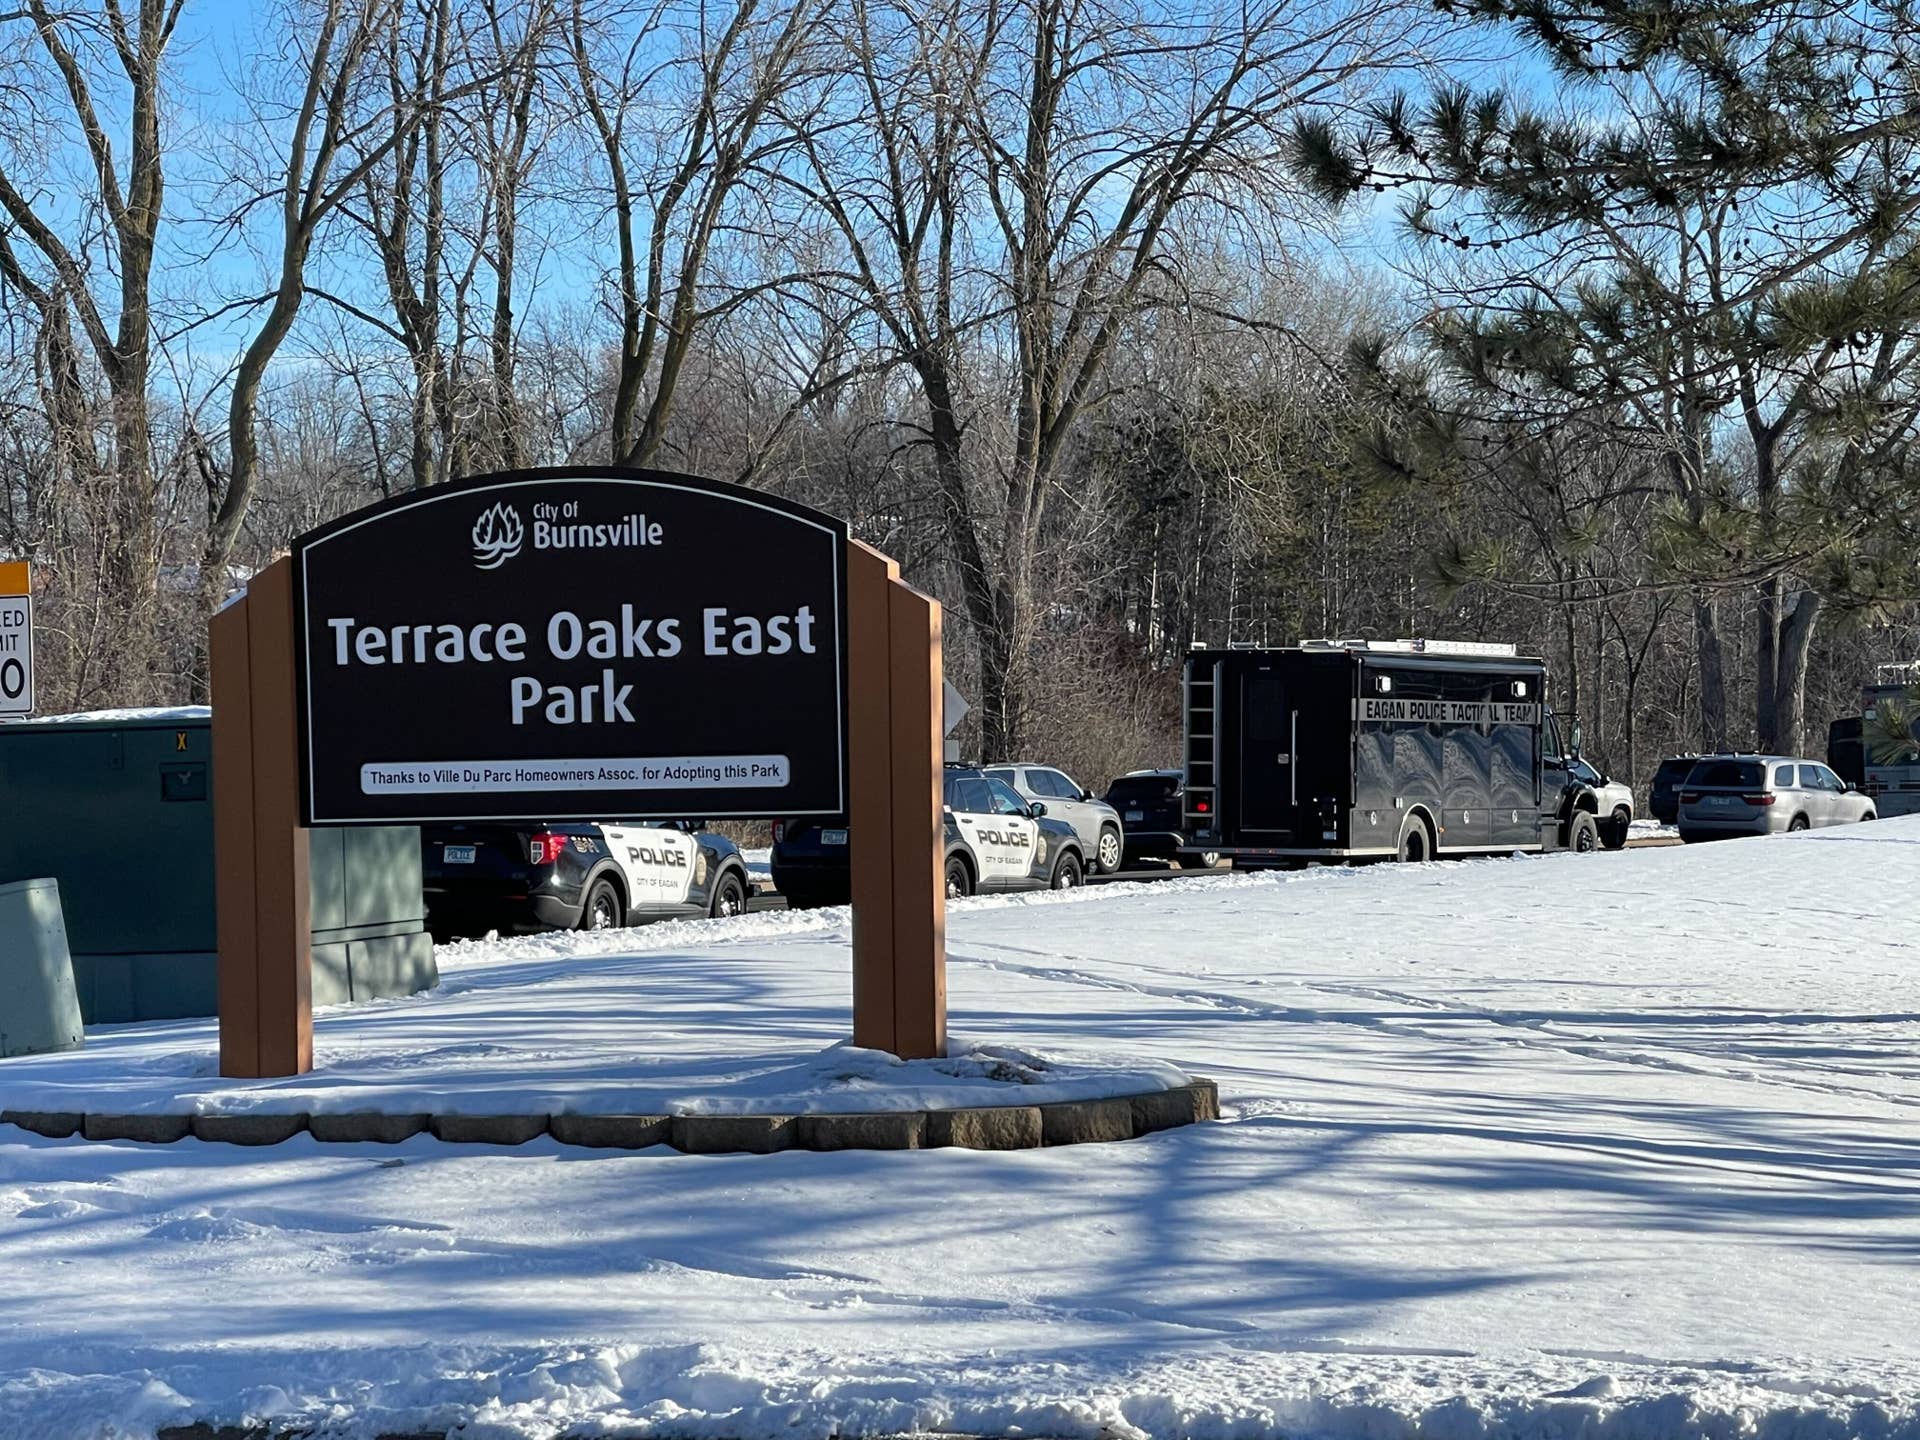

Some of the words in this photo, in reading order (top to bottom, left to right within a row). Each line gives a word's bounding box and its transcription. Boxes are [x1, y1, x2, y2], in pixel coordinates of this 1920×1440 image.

[533, 502, 558, 522] City
[563, 501, 578, 518] Of
[534, 514, 663, 549] Burnsville
[0, 610, 25, 627] ED
[328, 618, 527, 665] Terrace
[547, 604, 682, 660] Oaks
[703, 605, 816, 656] East
[511, 669, 636, 724] Park
[1367, 701, 1406, 719] EAGAN
[1410, 702, 1447, 720] POLICE
[1504, 704, 1532, 722] TEAM
[370, 771, 415, 784] Thanks
[418, 771, 431, 784] to
[433, 769, 460, 783] Ville
[464, 769, 480, 782] Du
[484, 769, 512, 782] Parc
[515, 768, 595, 782] Homeowners
[598, 767, 639, 780] Assoc.
[642, 766, 660, 780] for
[663, 766, 721, 781] Adopting
[725, 765, 748, 778] this
[751, 764, 780, 777] Park
[976, 829, 1030, 847] POLICE
[627, 846, 687, 868] POLICE
